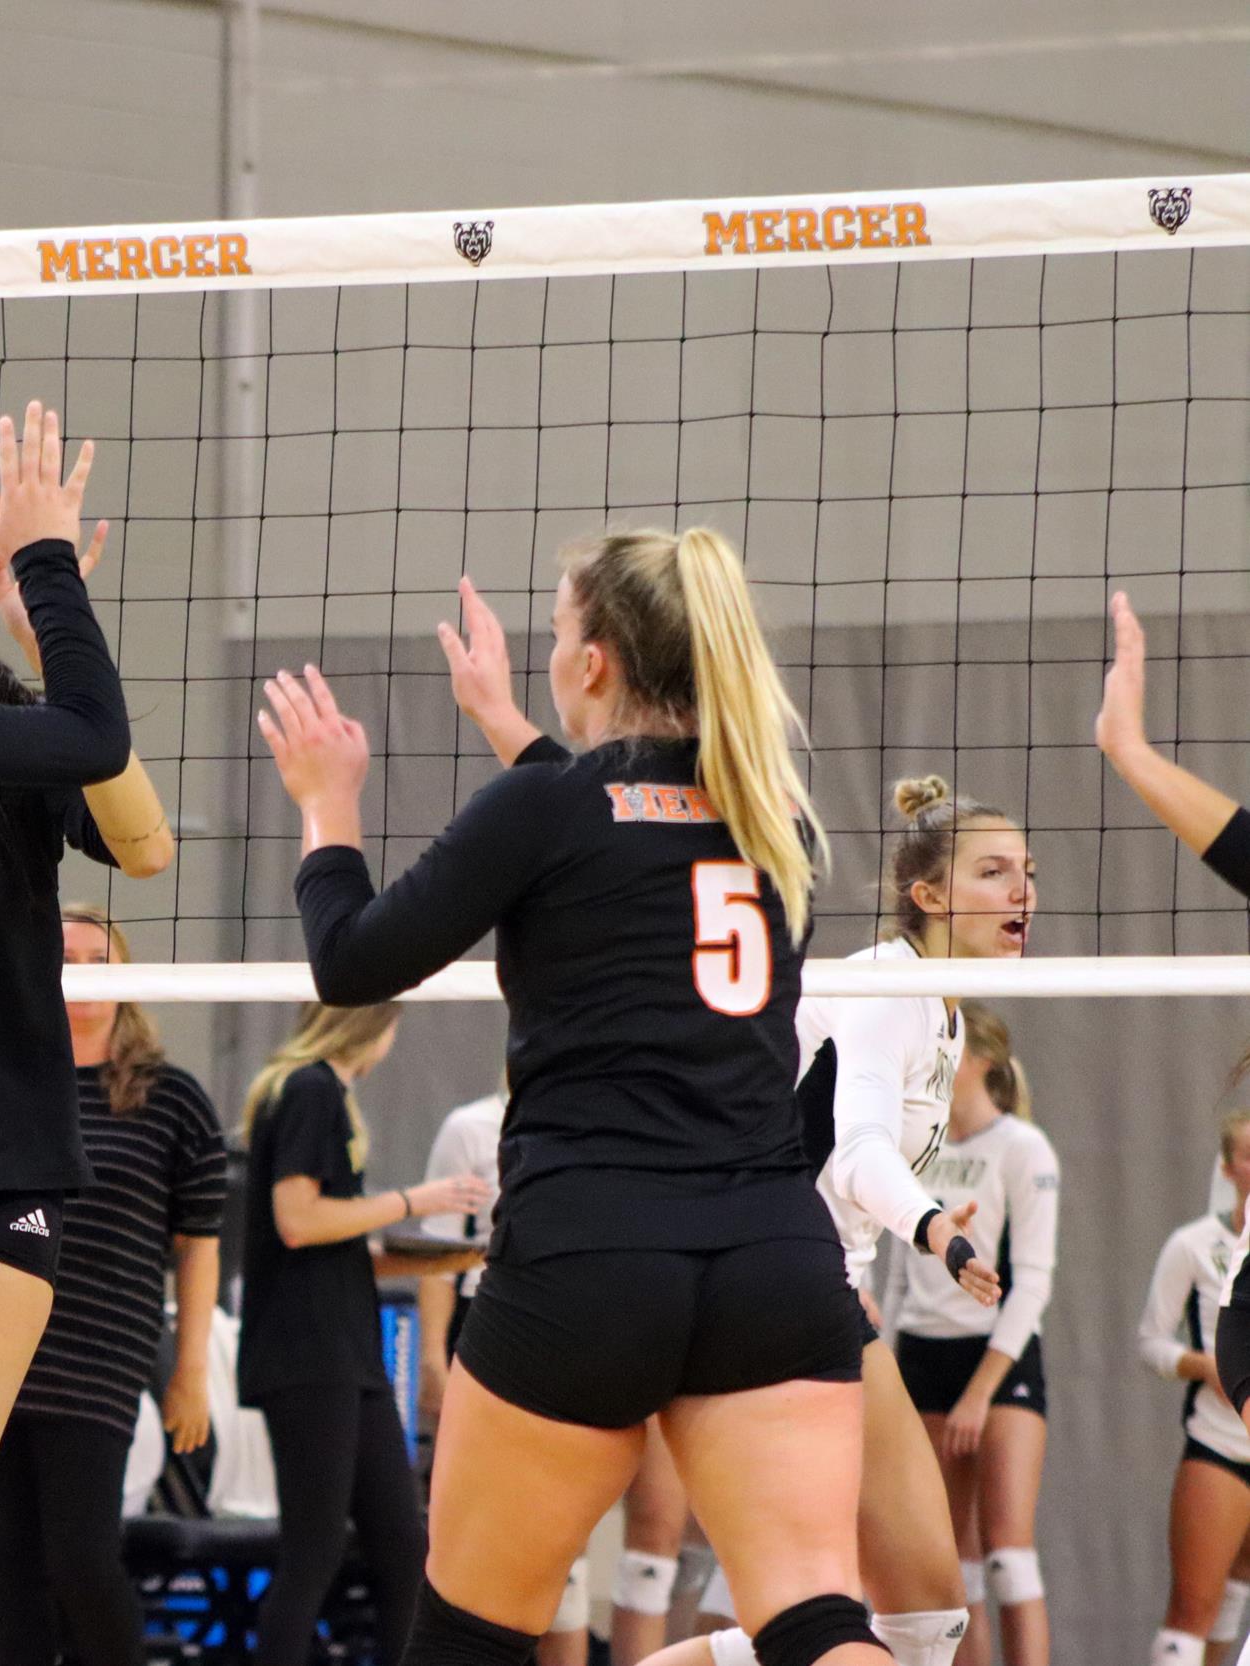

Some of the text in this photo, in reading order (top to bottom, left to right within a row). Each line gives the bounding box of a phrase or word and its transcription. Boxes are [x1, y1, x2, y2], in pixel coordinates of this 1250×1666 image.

[701, 201, 932, 256] MERCER
[37, 232, 253, 283] MERCER
[691, 858, 772, 1017] 5
